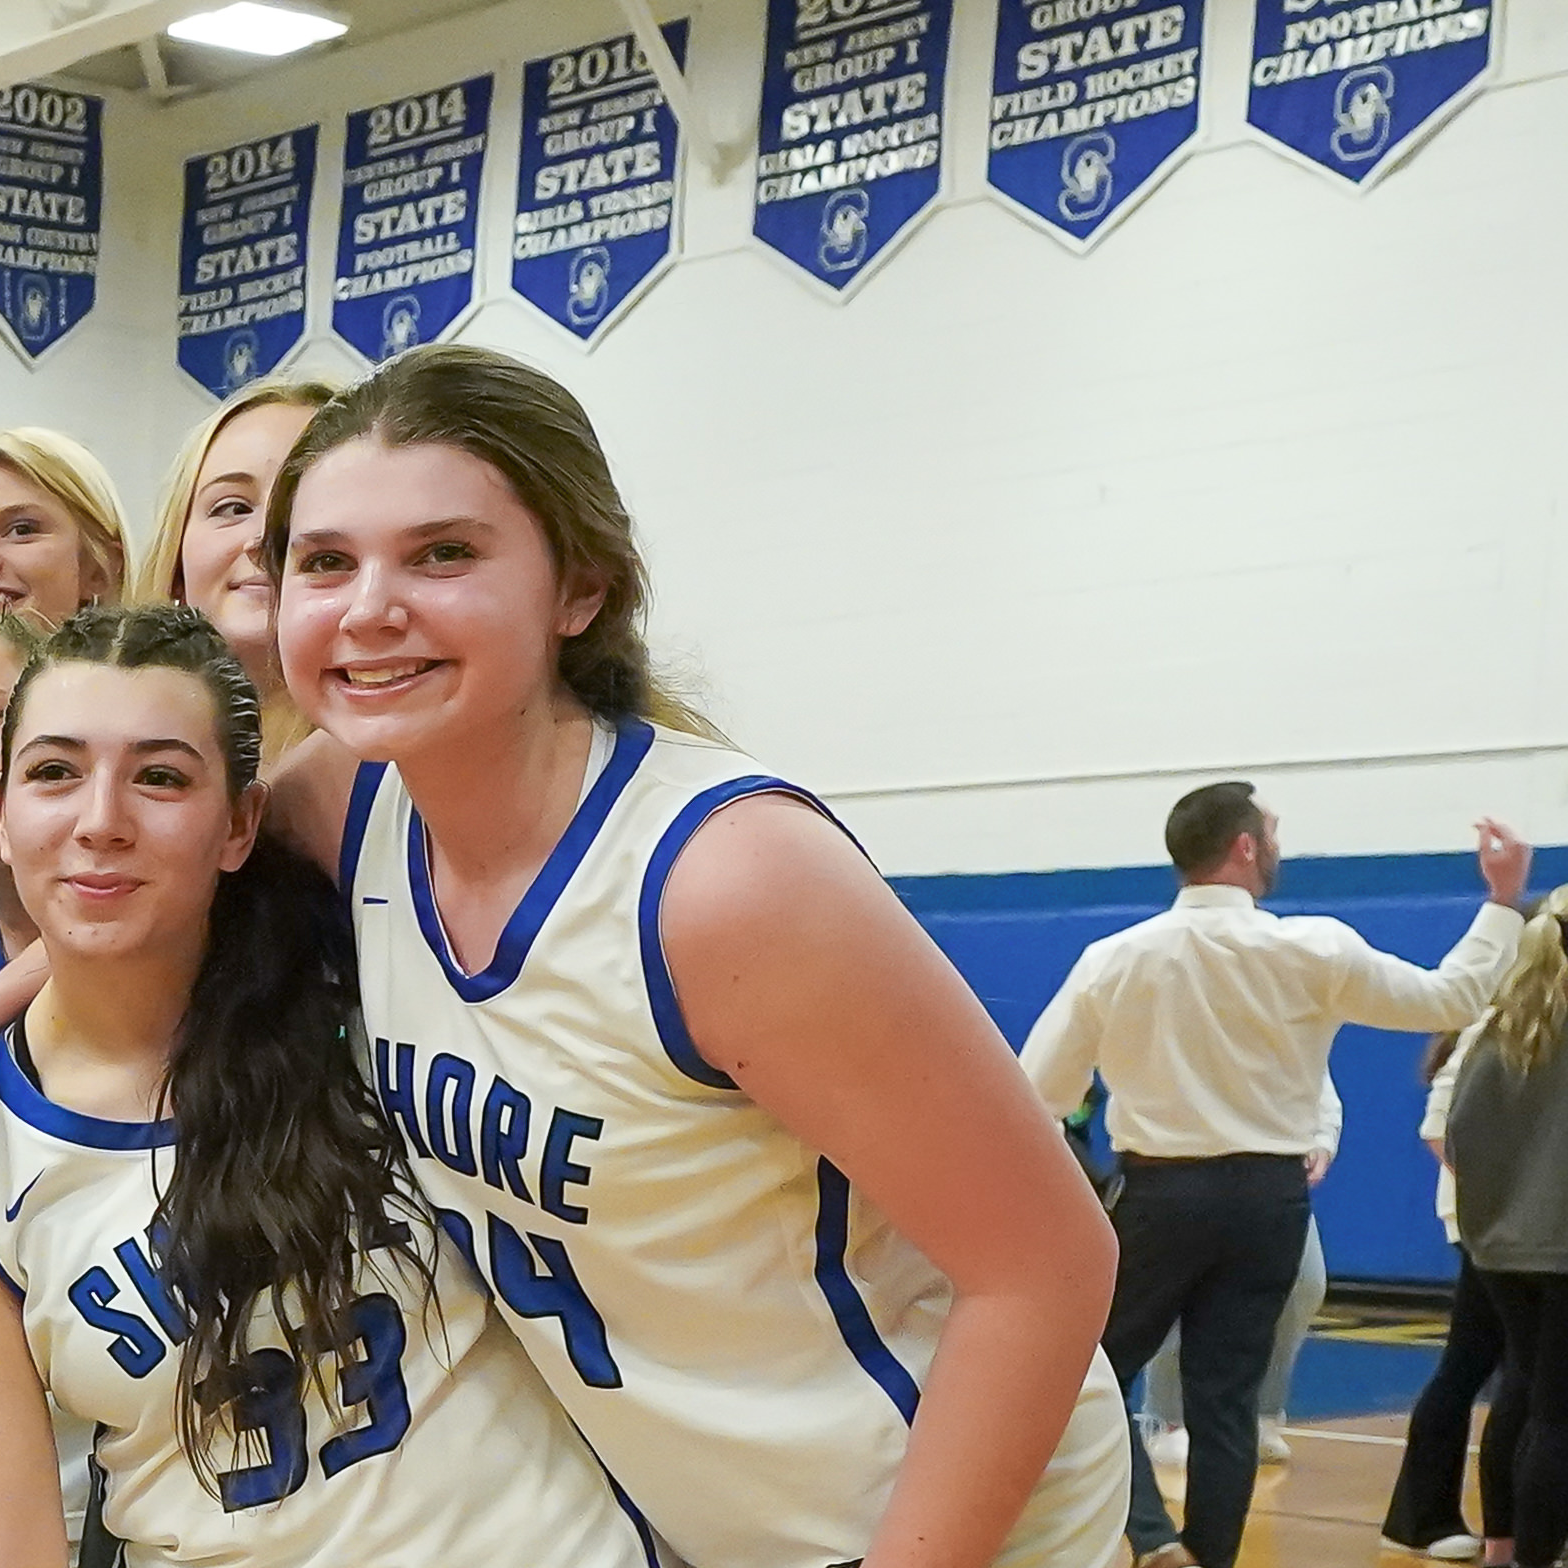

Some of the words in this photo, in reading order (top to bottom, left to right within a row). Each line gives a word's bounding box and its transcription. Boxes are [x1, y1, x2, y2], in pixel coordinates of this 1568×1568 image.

[1017, 5, 1185, 81] STATE
[367, 86, 466, 145] 2014
[781, 72, 927, 142] STATE
[991, 76, 1196, 149] CHAMPIONS
[992, 80, 1078, 120] FIELD
[1084, 47, 1199, 100] HOCKEY
[205, 136, 295, 192] 2014
[535, 141, 661, 199] STATE
[354, 189, 466, 245] STATE
[195, 232, 298, 284] STATE
[376, 1037, 604, 1225] HORE
